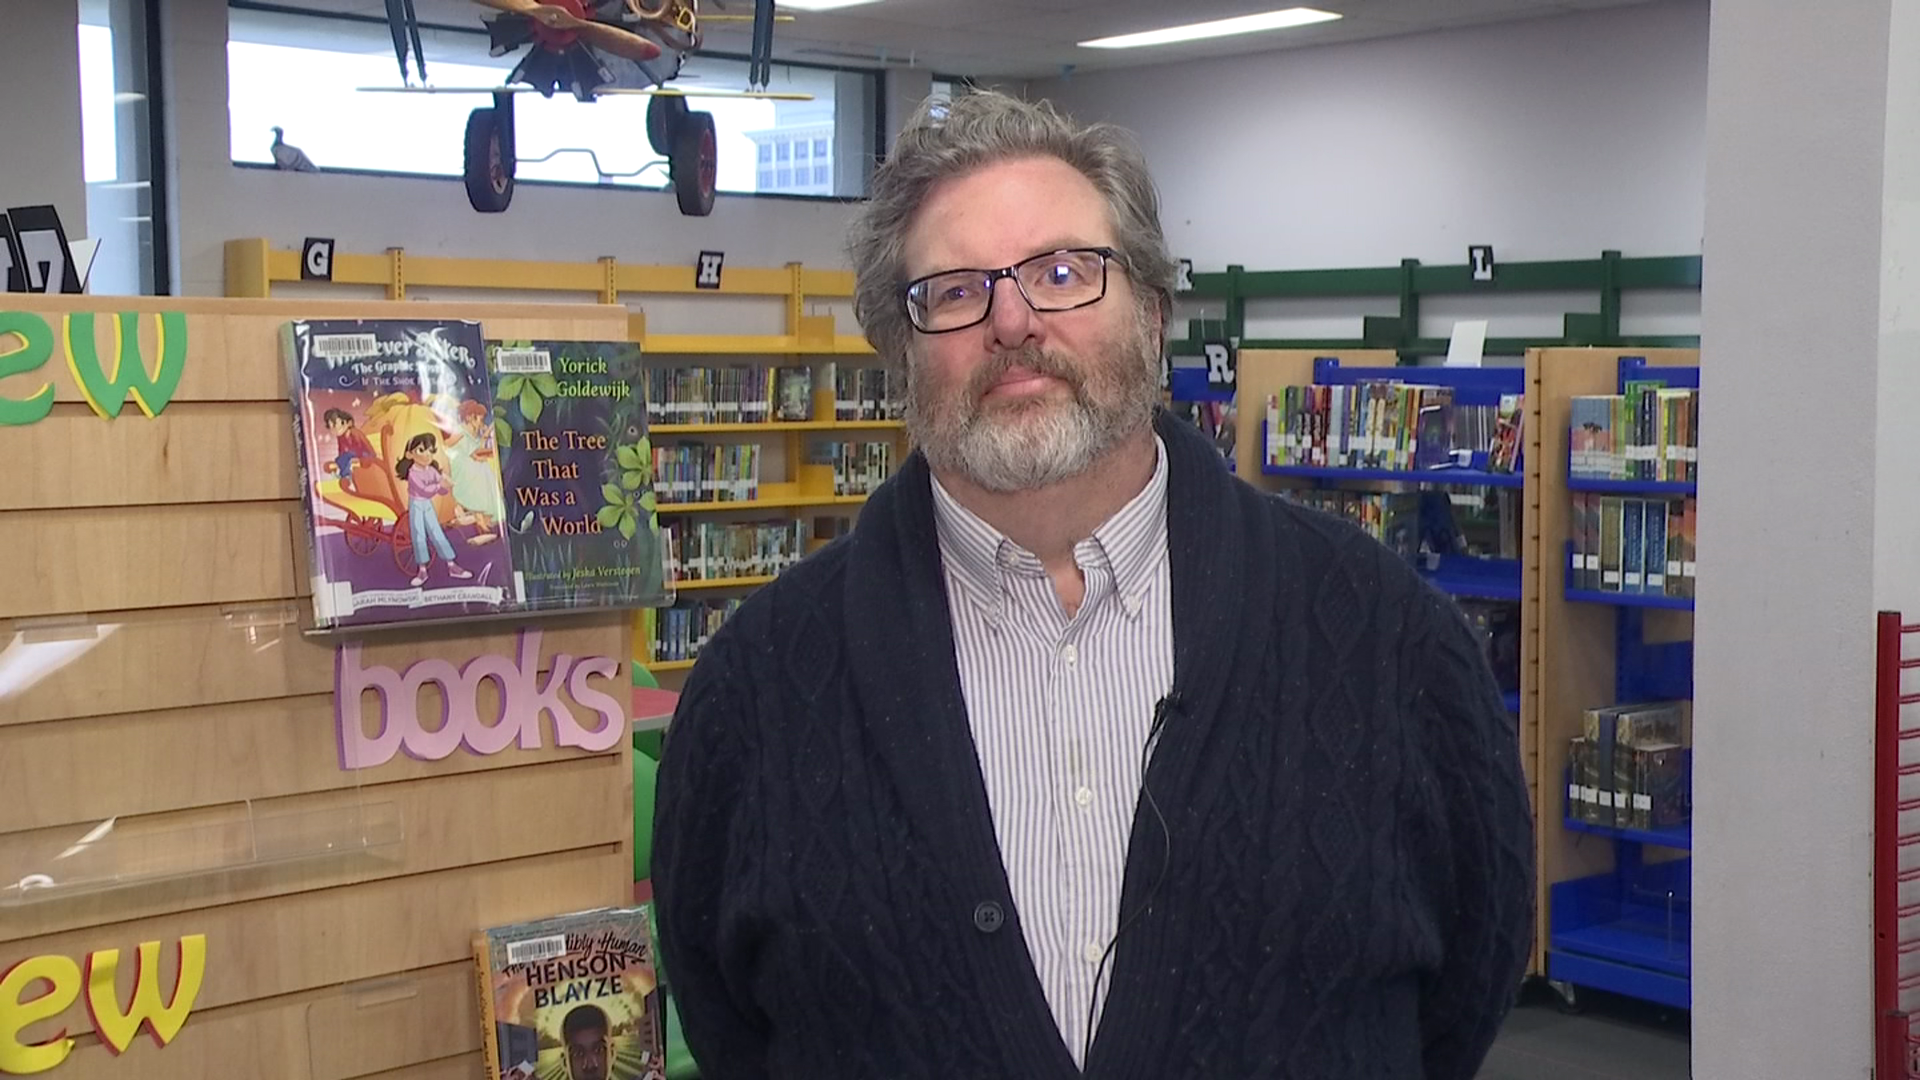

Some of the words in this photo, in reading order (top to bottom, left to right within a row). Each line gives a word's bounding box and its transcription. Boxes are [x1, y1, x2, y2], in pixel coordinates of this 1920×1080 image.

[307, 242, 329, 276] G
[699, 255, 721, 284] H
[1473, 249, 1492, 280] L
[351, 362, 373, 375] The
[559, 357, 608, 374] Yorick
[1204, 343, 1235, 384] R
[557, 380, 631, 402] Goldewijk
[520, 430, 559, 451] The
[563, 429, 607, 450] Tree
[532, 459, 580, 480] That
[516, 487, 561, 507] Was
[565, 490, 577, 506] a
[541, 513, 603, 536] World
[562, 571, 572, 584] by
[334, 625, 625, 770] books
[597, 931, 647, 957] Human
[525, 954, 626, 987] HENSON
[534, 974, 624, 1009] BLAYZE
